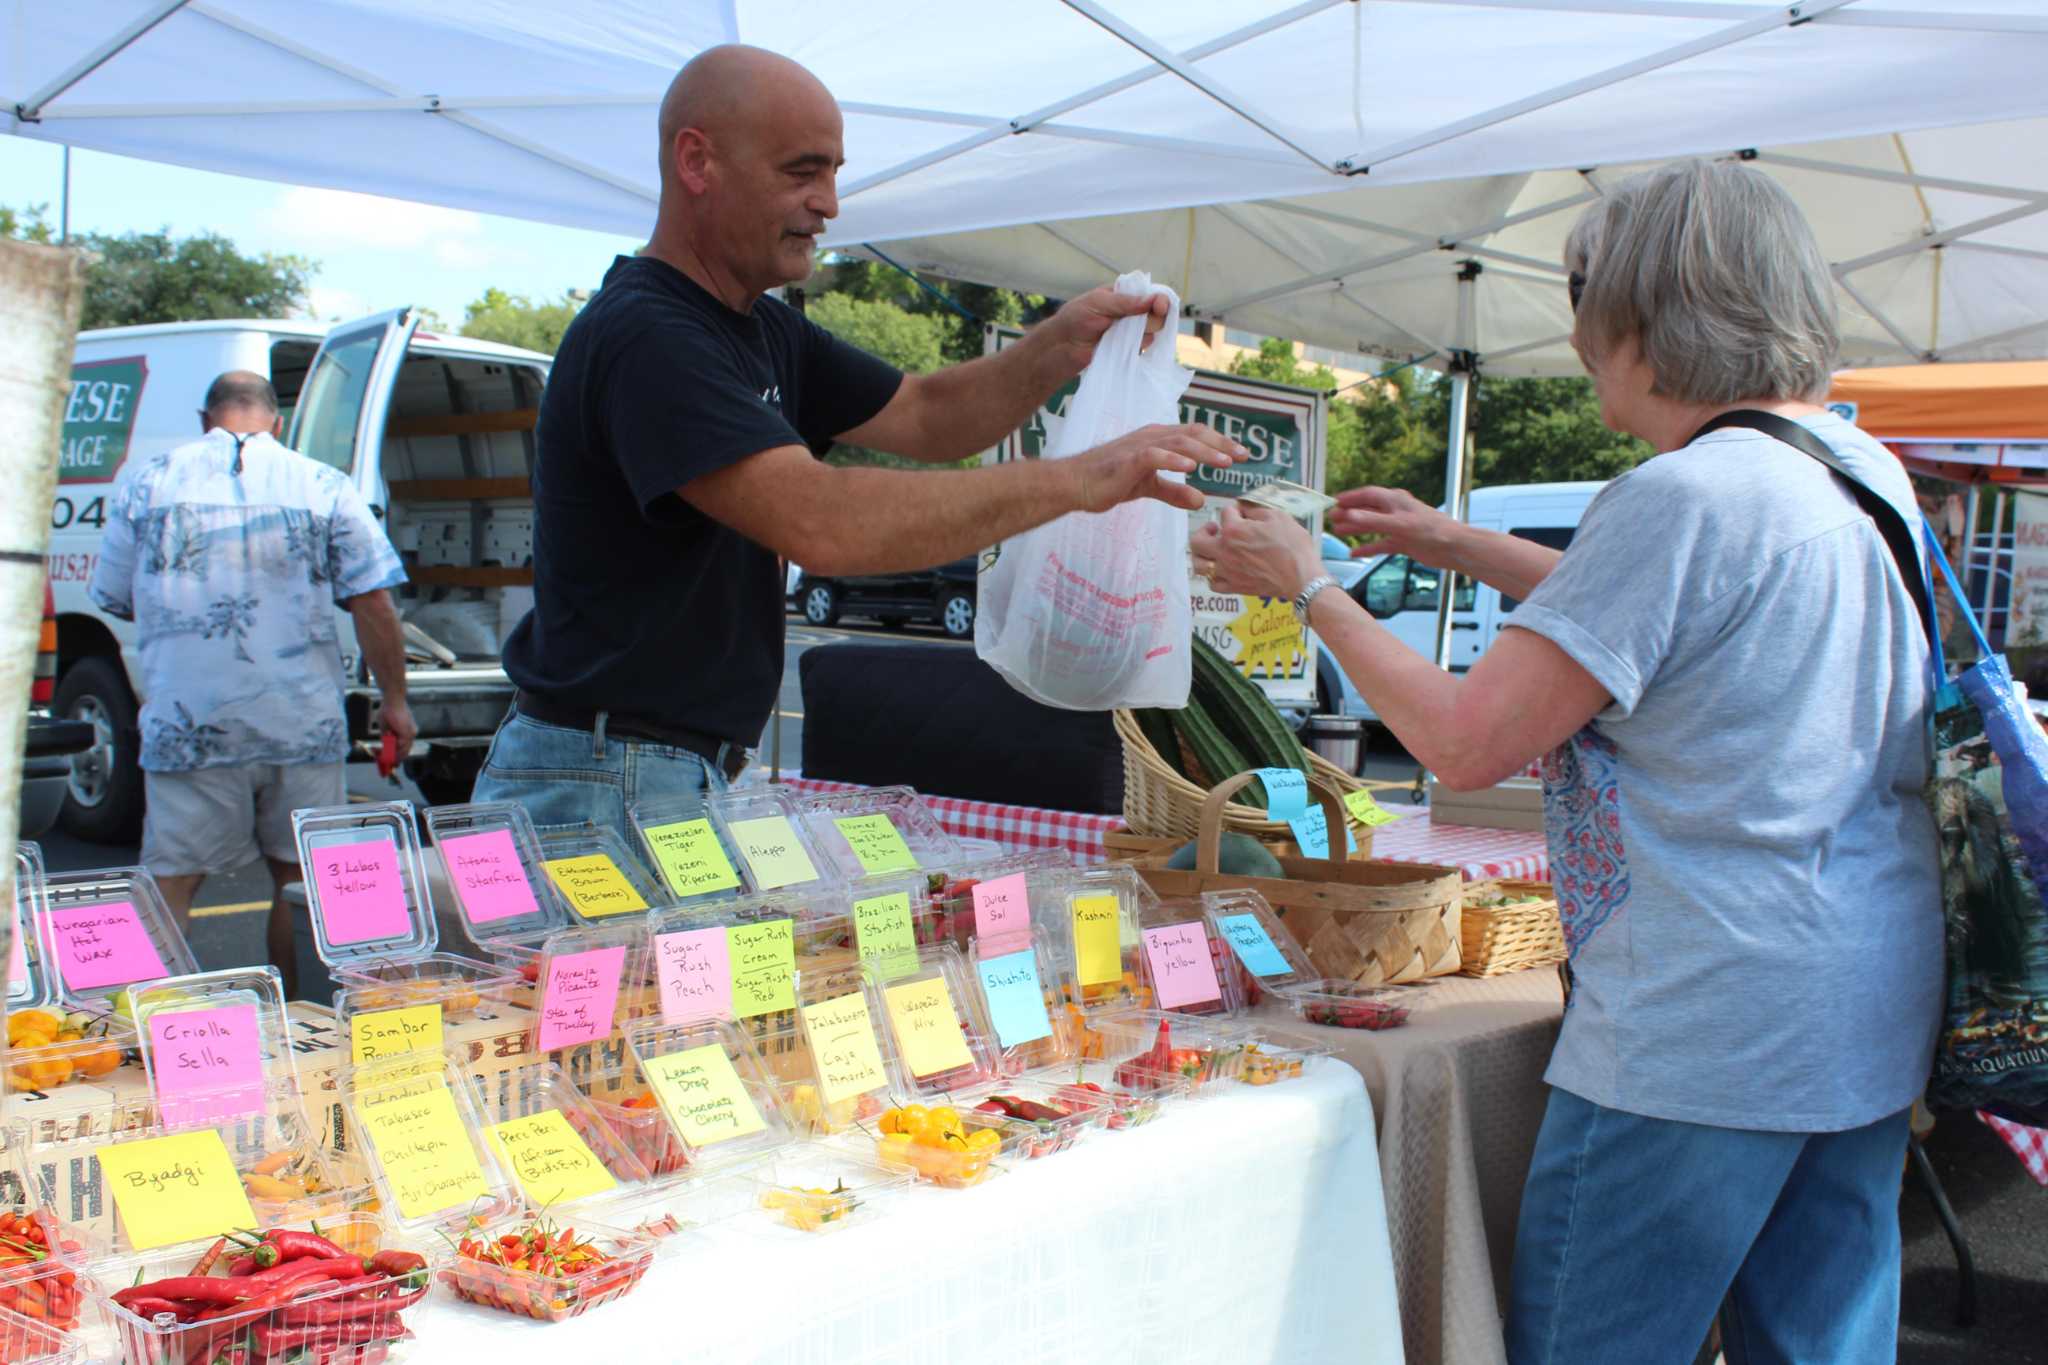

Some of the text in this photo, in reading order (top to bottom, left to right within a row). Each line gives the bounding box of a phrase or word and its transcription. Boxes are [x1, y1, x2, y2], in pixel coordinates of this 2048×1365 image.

[64, 381, 131, 423] ESE
[60, 435, 107, 468] AGE
[1250, 641, 1268, 656] per
[664, 840, 695, 853] Tiger
[750, 845, 786, 858] Aleppo
[457, 853, 502, 869] Atomic
[327, 863, 341, 877] 3
[982, 894, 1009, 908] Dulce
[70, 934, 103, 948] Hot
[734, 925, 789, 949] Sugar Rush
[663, 940, 702, 960] Sugar
[742, 952, 778, 965] Cream
[672, 954, 712, 973] Rush
[669, 977, 715, 999] Peach
[735, 969, 791, 991] Sugar Rush
[751, 985, 775, 1003] Red
[574, 1003, 587, 1020] of
[162, 1020, 231, 1042] Criolla
[360, 1016, 429, 1042] Sambar
[177, 1045, 230, 1070] Sella
[662, 1065, 705, 1081] Lemon
[677, 1077, 711, 1093] Drop
